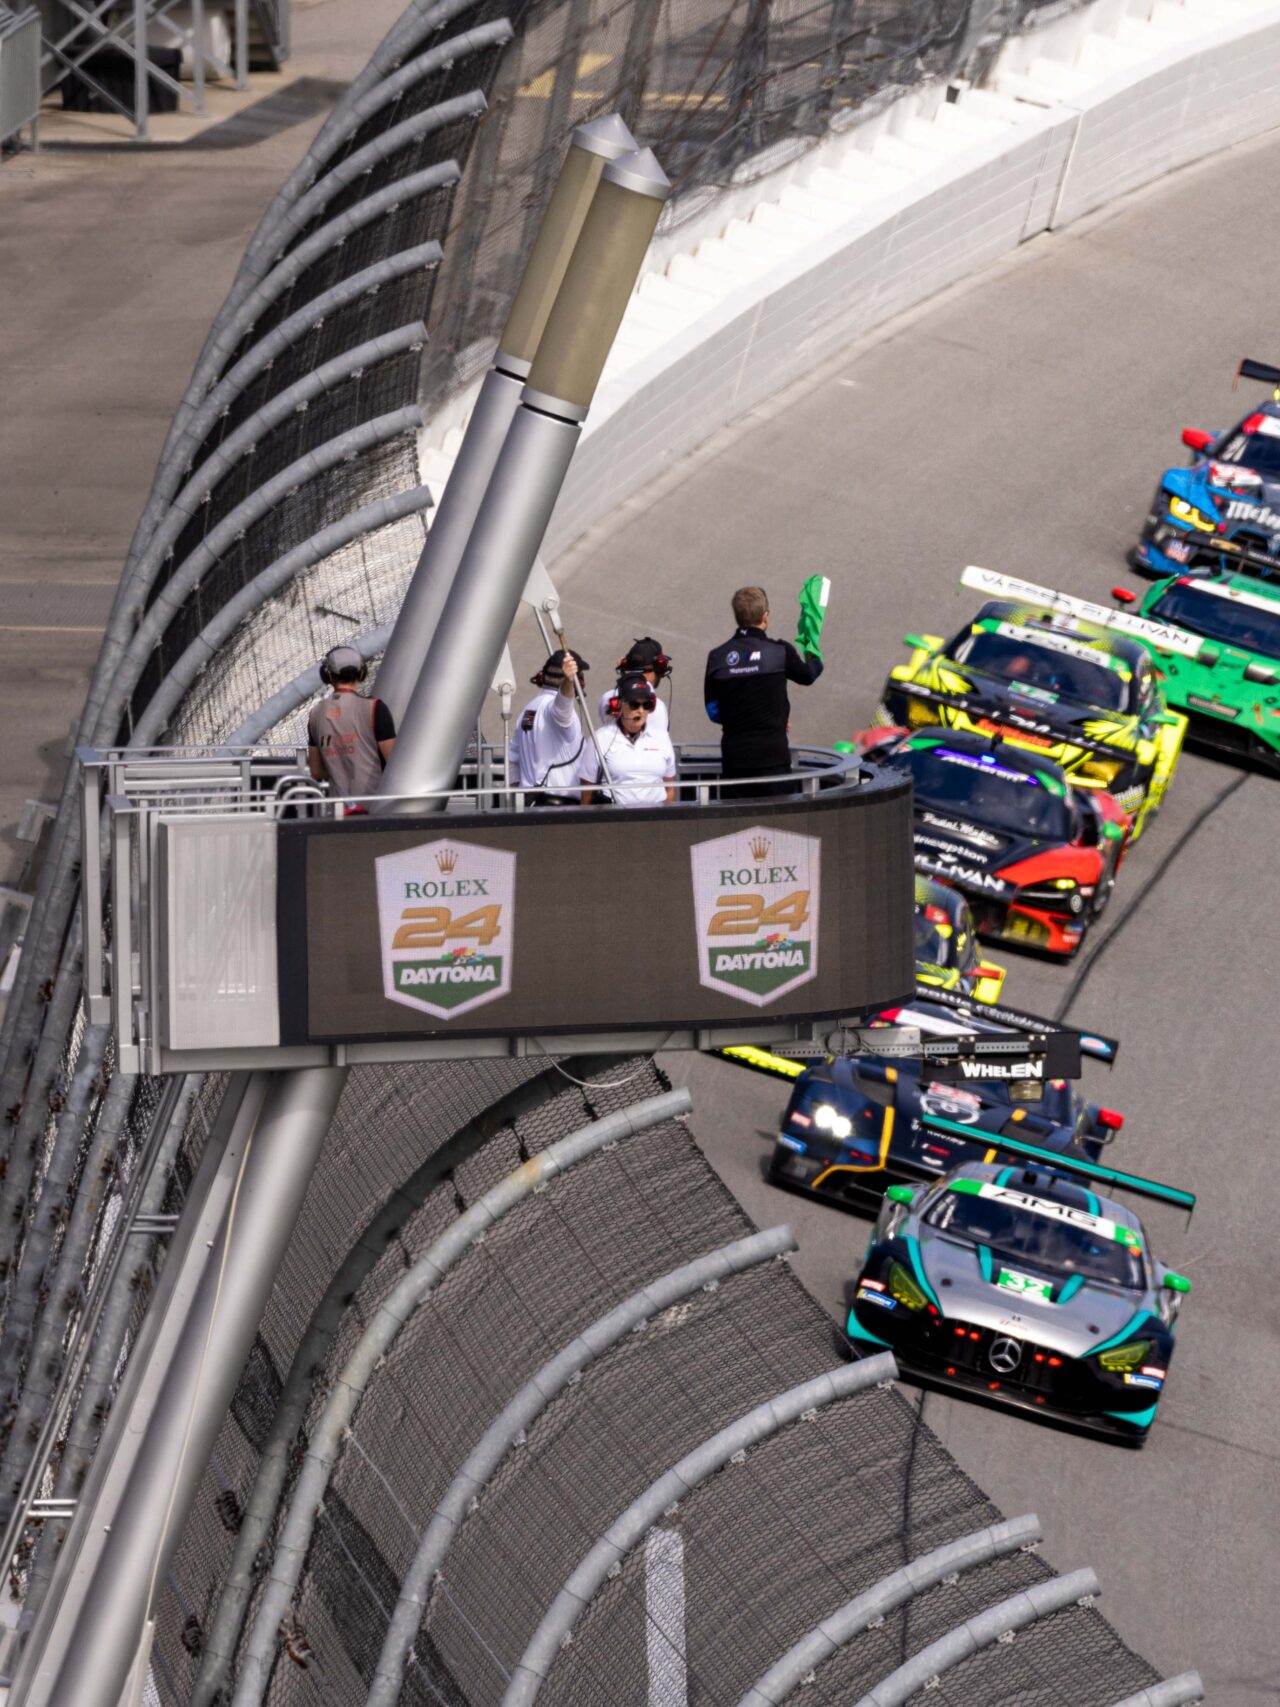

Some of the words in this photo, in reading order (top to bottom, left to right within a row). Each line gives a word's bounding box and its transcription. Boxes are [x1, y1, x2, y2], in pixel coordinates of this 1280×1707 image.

[719, 865, 798, 886] ROLEX
[404, 879, 489, 898] ROLEX
[707, 890, 810, 936] 24
[392, 904, 502, 949] 24
[715, 949, 804, 971] DAYTONA
[400, 964, 496, 985] DAYTONA
[961, 1060, 1043, 1078] WHELEN
[994, 1191, 1098, 1228] AMG
